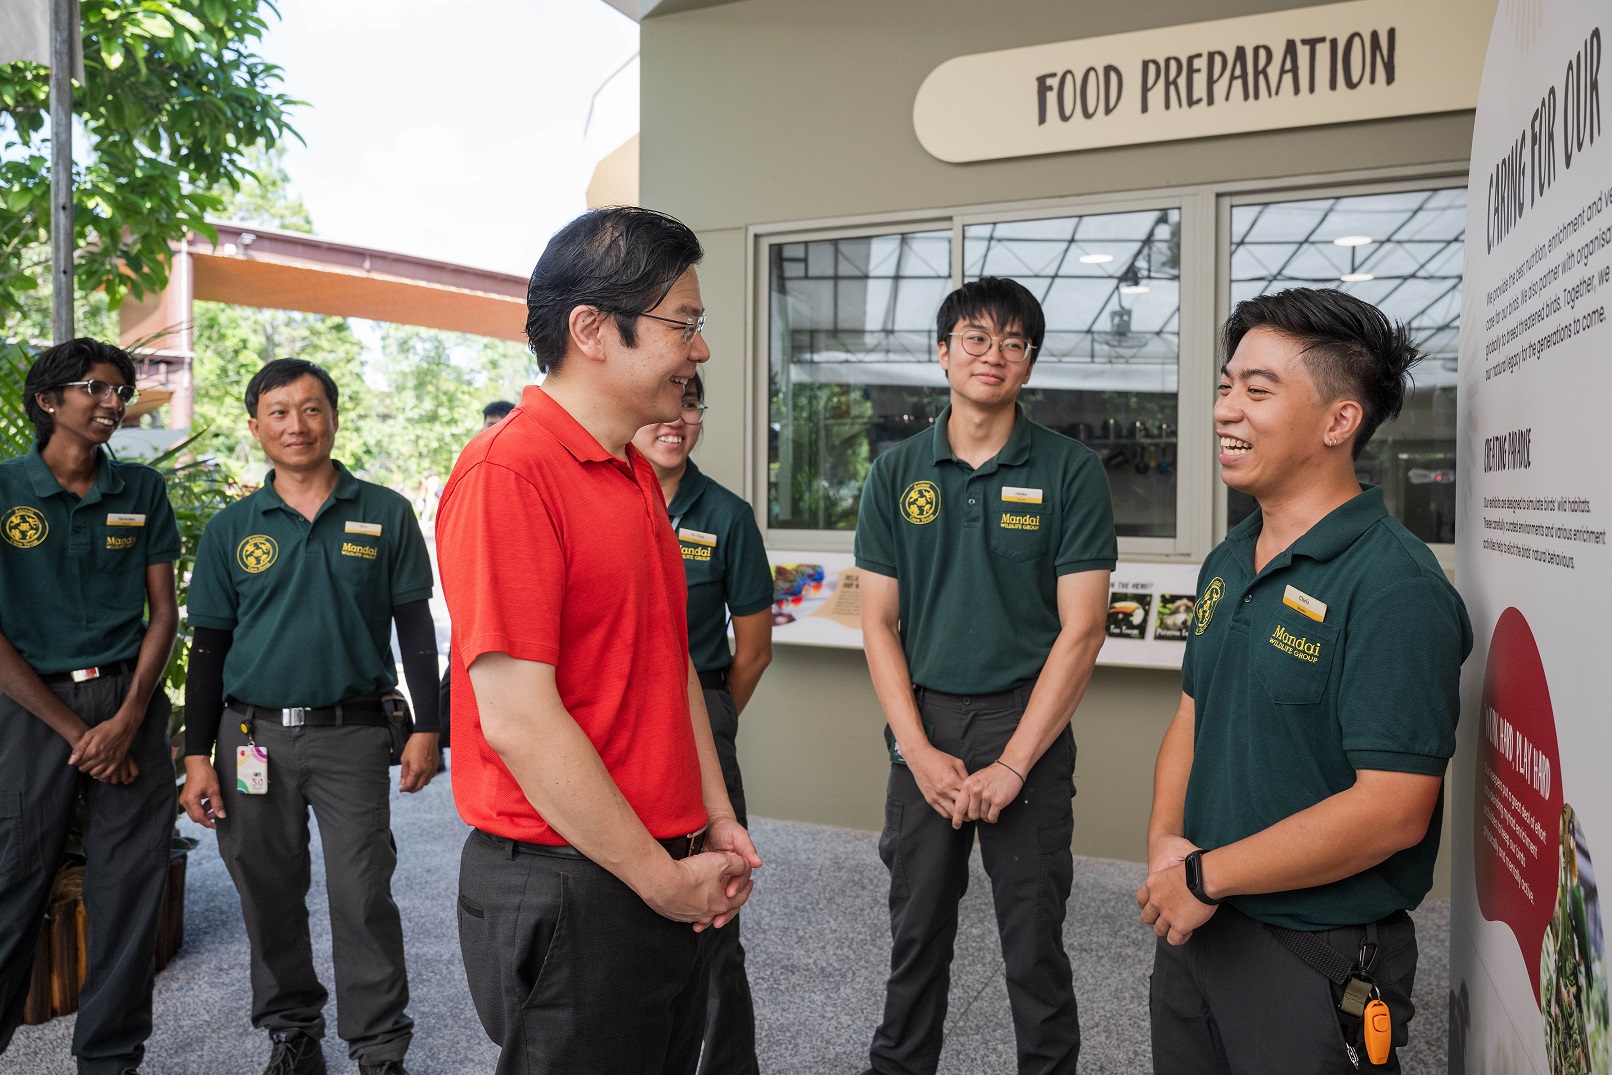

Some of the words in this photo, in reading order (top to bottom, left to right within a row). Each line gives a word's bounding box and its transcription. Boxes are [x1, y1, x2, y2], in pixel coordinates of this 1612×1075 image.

[1036, 64, 1123, 126] FOOD
[1140, 27, 1396, 114] PREPARATION
[1487, 129, 1525, 255] CARING
[1531, 85, 1556, 210] FOR
[1564, 27, 1601, 169] OUR
[1548, 206, 1585, 253] enrichment
[1587, 190, 1602, 221] and
[1521, 288, 1527, 306] We
[1528, 280, 1538, 299] also
[1539, 264, 1560, 298] partner
[1561, 249, 1575, 275] with
[1519, 302, 1544, 335] threatened
[1563, 275, 1596, 309] Together,
[1598, 265, 1610, 287] we
[1528, 341, 1536, 358] the
[1537, 323, 1571, 360] generations
[1573, 317, 1580, 335] to
[1582, 306, 1606, 331] come.
[1484, 435, 1506, 473] CREATING
[1508, 428, 1531, 470] PARADISE
[1001, 513, 1040, 525] Mandai
[1557, 496, 1567, 512] wild
[342, 542, 378, 556] Mandai
[680, 544, 711, 556] andai
[1519, 520, 1544, 536] environments
[1545, 523, 1554, 538] and
[1555, 523, 1572, 540] various
[1573, 525, 1606, 545] enrichment
[1532, 547, 1547, 563] natural
[1269, 637, 1293, 654] WILDLIFE
[1293, 650, 1318, 663] GROUP
[1272, 624, 1321, 656] Mandai
[1516, 730, 1532, 784] PLAY
[1534, 748, 1550, 800] HARD
